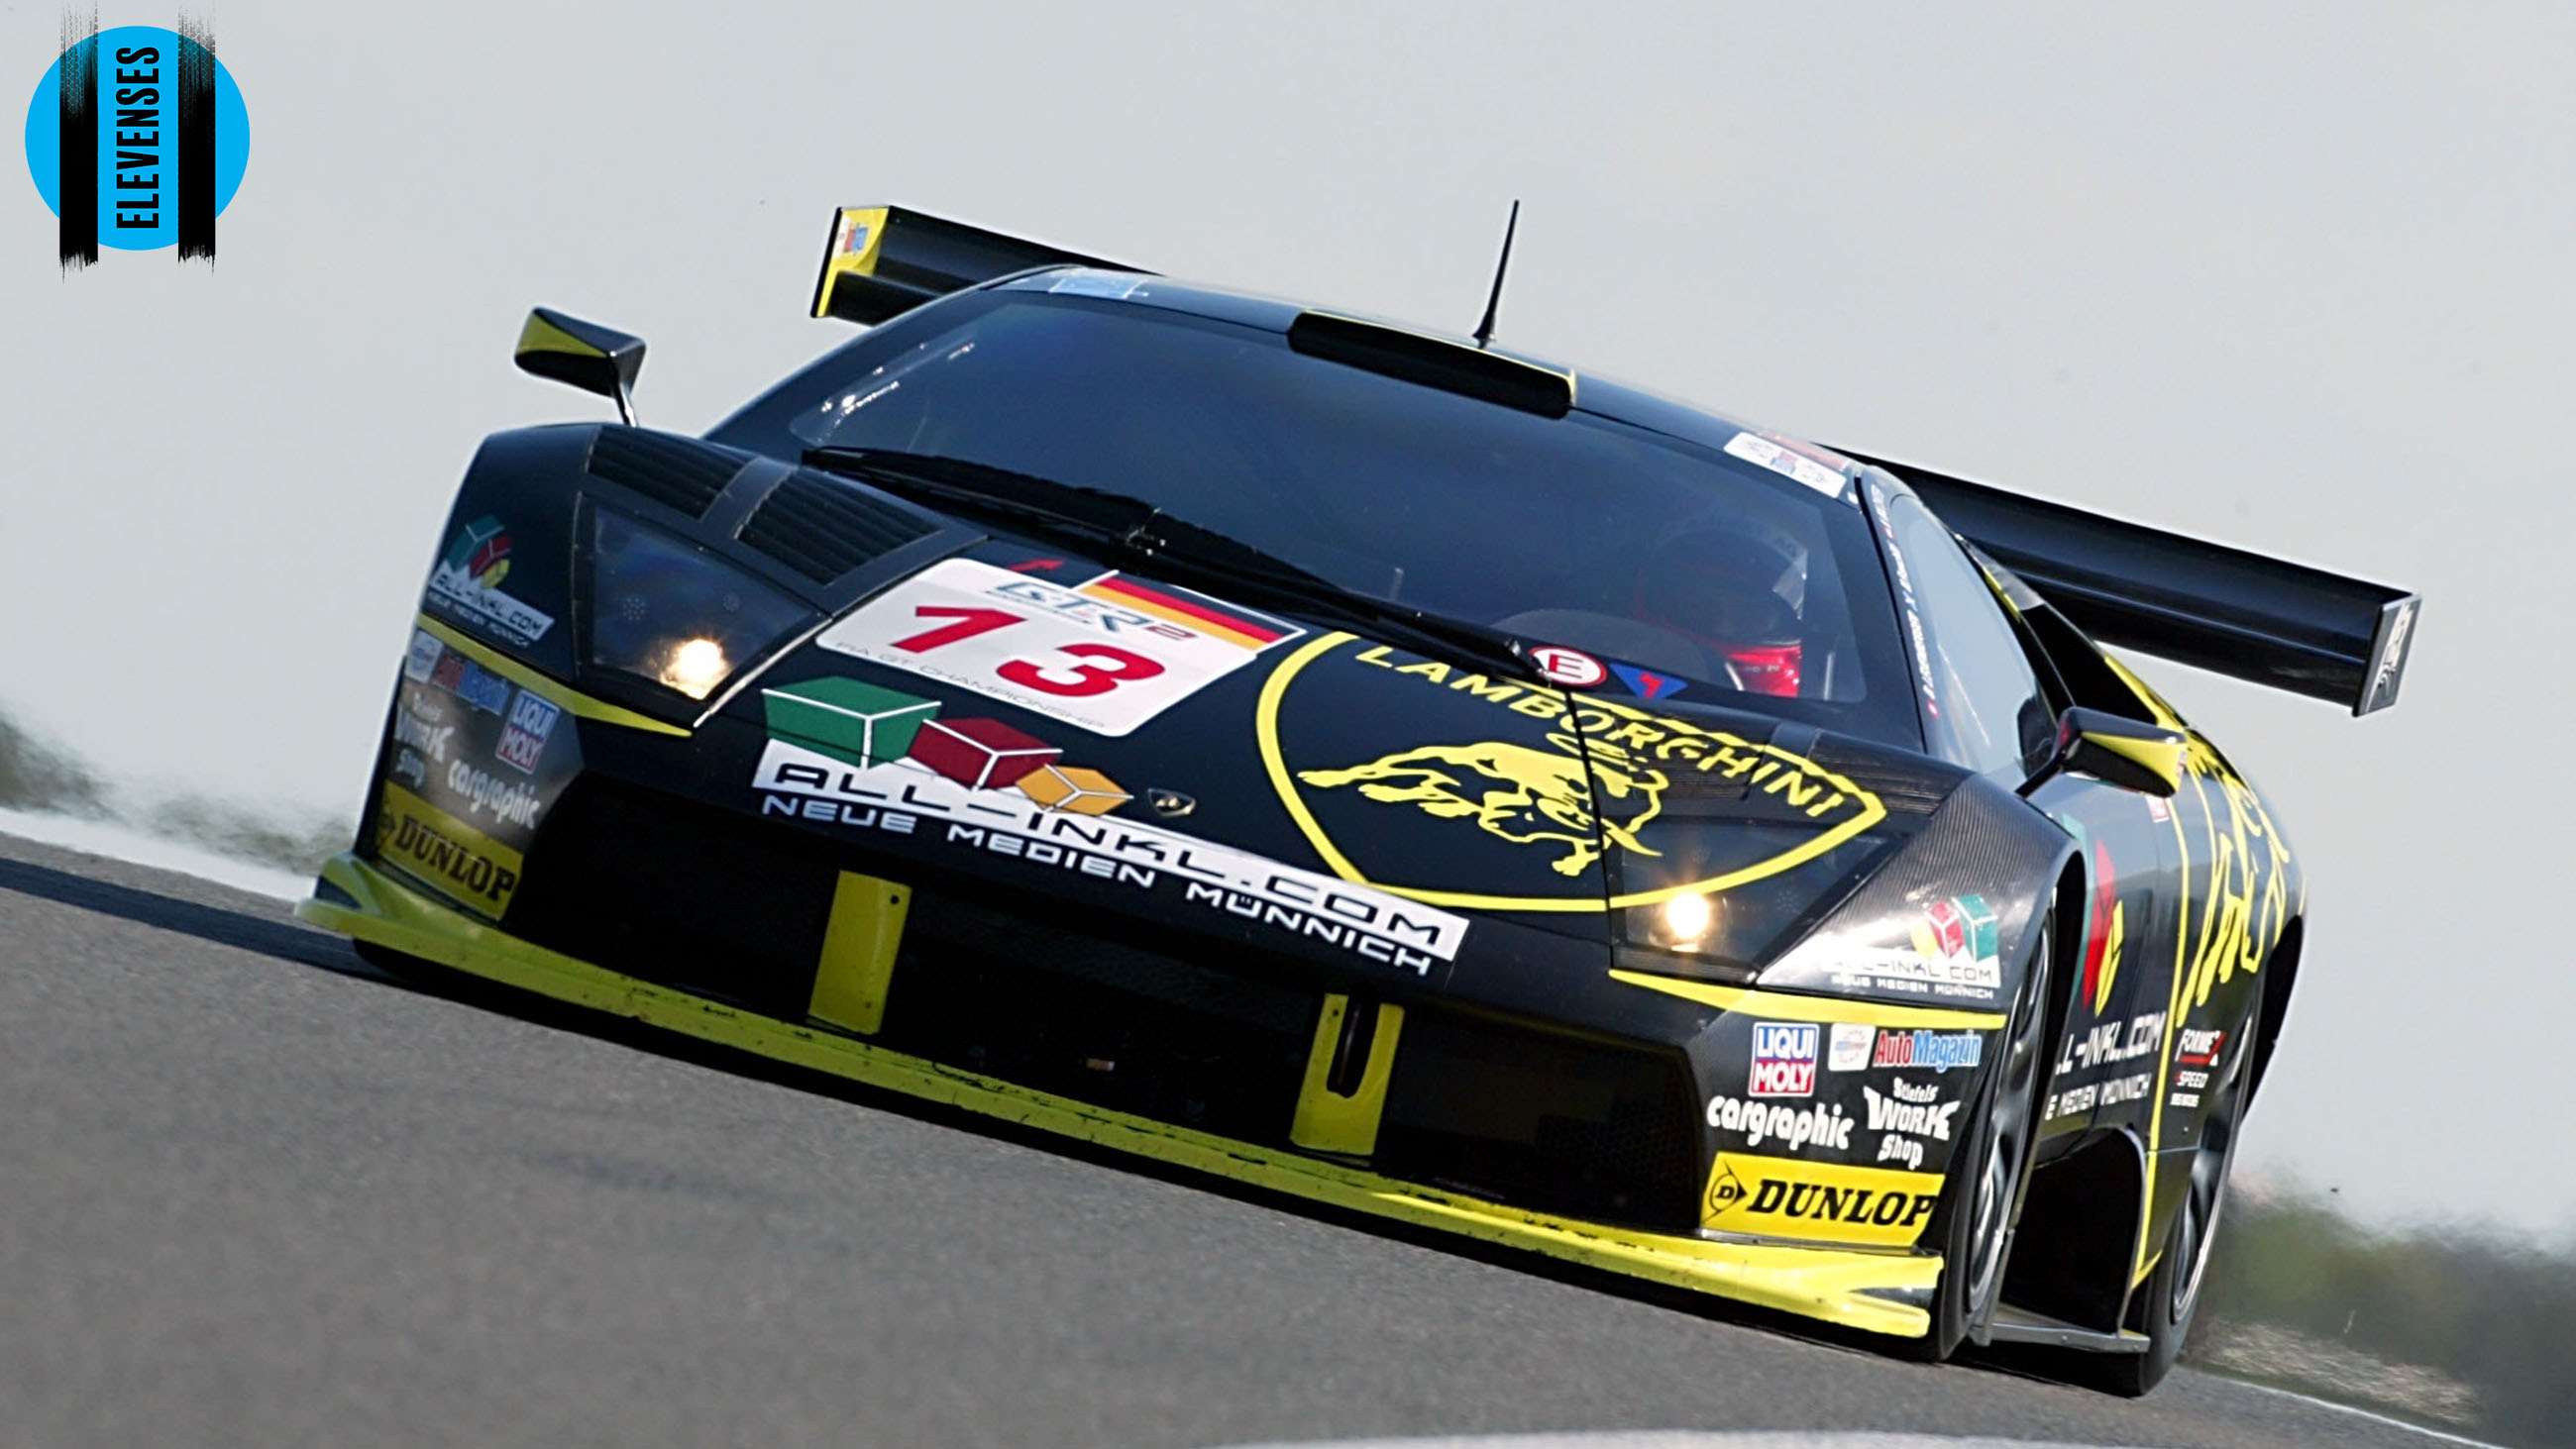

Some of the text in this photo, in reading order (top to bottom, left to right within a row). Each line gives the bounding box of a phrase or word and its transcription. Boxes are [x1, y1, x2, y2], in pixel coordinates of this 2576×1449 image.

[890, 605, 1167, 697] 13
[512, 694, 557, 739] LIQUI
[1354, 645, 1845, 818] LAMBORGHINI
[499, 724, 546, 774] MOLY
[448, 759, 541, 830] cargraphic
[394, 814, 516, 902] DUNLOP
[774, 762, 1442, 947] ALL-INKL.COM
[761, 794, 1433, 978] NEUE MEDIEN MÜNNICH
[1757, 1027, 1814, 1060] LIQUI
[1872, 1028, 1983, 1074] AutoMagazin
[1752, 1062, 1814, 1094] MOLY
[1706, 1094, 1856, 1152] cargraphic
[1863, 1085, 1962, 1142] WORK
[1877, 1133, 1924, 1172] Shop
[1746, 1178, 1939, 1227] DUNLOP
